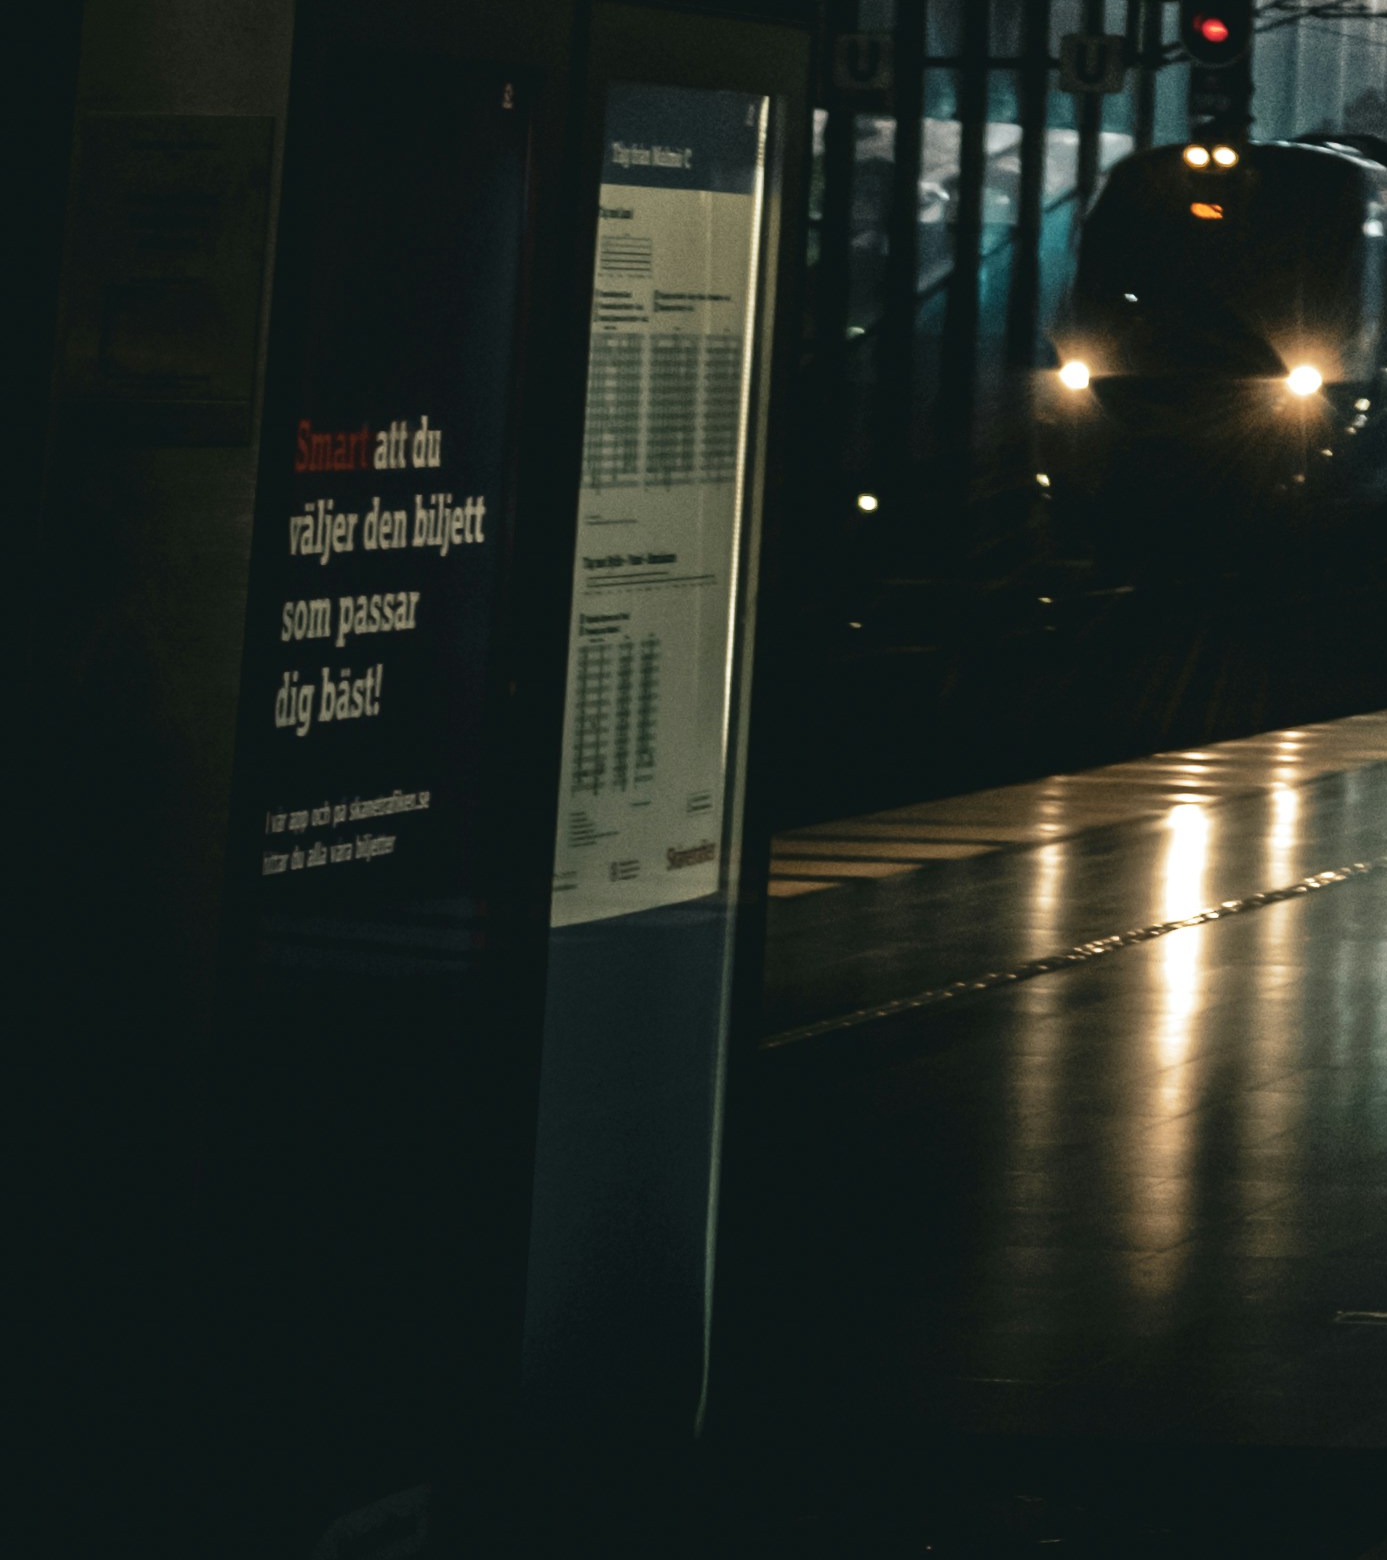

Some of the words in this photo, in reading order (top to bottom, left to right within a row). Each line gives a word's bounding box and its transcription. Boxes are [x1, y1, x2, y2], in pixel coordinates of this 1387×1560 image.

[295, 418, 369, 472] Smart
[374, 421, 408, 470] att
[412, 415, 443, 469] du
[290, 498, 359, 566] väljer
[363, 496, 408, 551] den
[412, 492, 486, 557] biljett
[281, 597, 332, 641] som
[335, 591, 421, 647] passar
[275, 670, 315, 737] dig
[318, 663, 384, 722] bäst!
